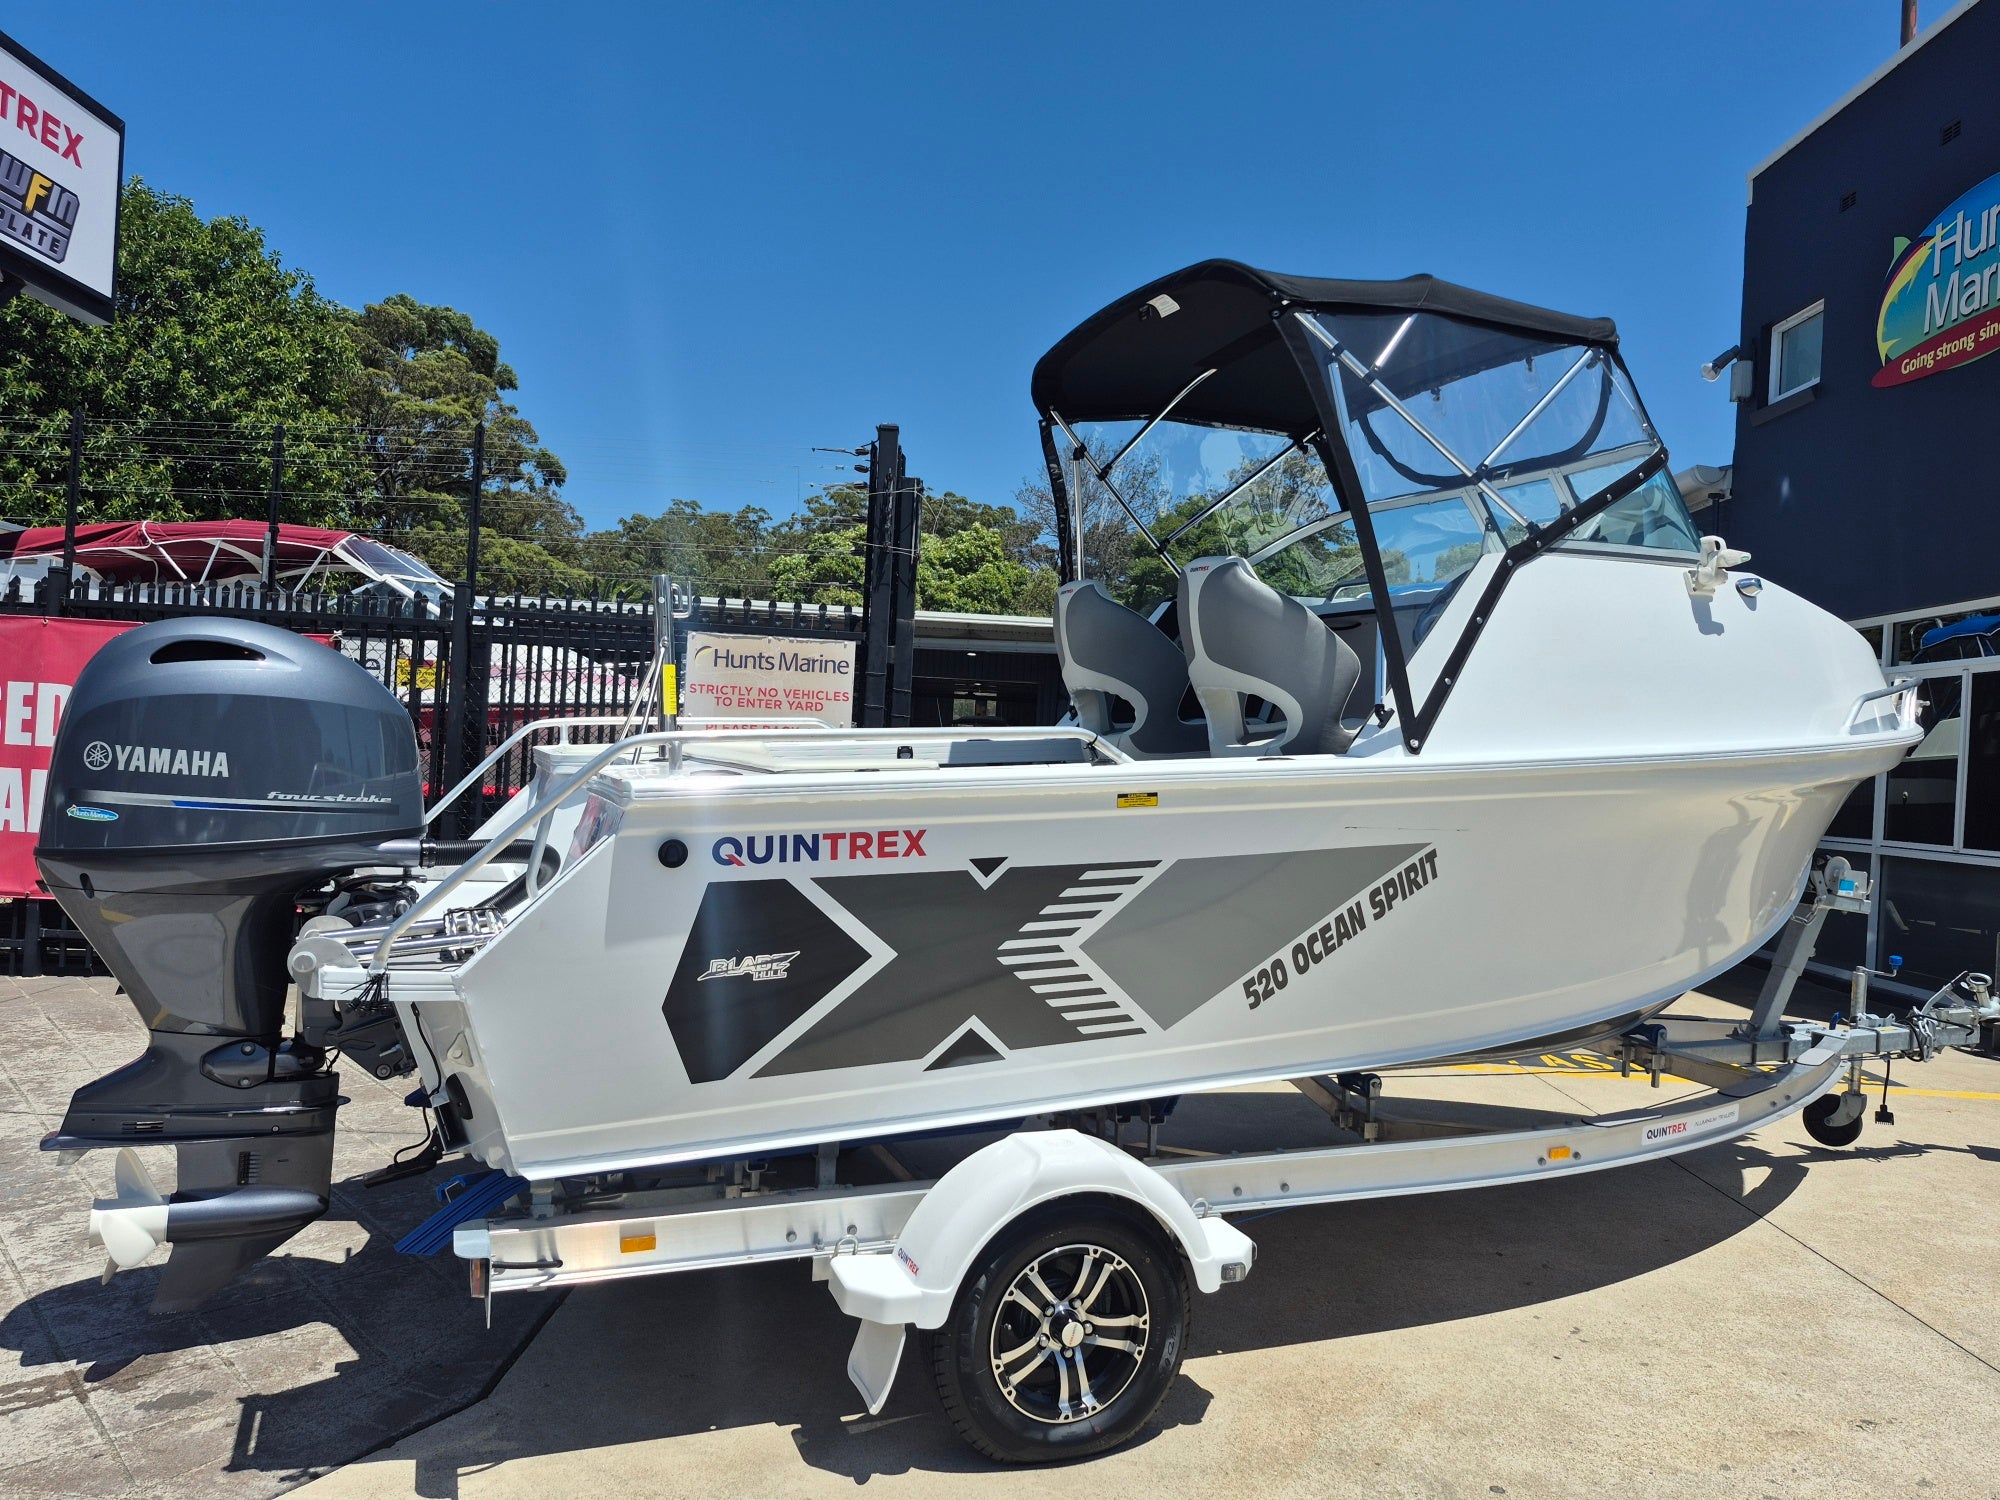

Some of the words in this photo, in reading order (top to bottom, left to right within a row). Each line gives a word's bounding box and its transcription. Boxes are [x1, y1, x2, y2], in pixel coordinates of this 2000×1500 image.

[1901, 350, 1935, 375] Going
[1936, 333, 1975, 360] strong
[1979, 320, 2000, 341] sin
[713, 649, 775, 671] Hunts
[778, 652, 850, 675] Marine
[690, 684, 753, 697] STRICTLY
[758, 687, 779, 698] NO
[783, 688, 850, 702] VEHICLES
[714, 696, 733, 707] TO
[738, 698, 782, 710] ENTER
[787, 700, 824, 712] YARD
[115, 744, 229, 778] YAMAHA
[711, 829, 928, 867] QUINTREX
[1243, 958, 1289, 1010] 520
[1291, 900, 1367, 975] OCEAN
[1368, 848, 1438, 921] SPIRIT
[1646, 1122, 1688, 1140] QUINTREX
